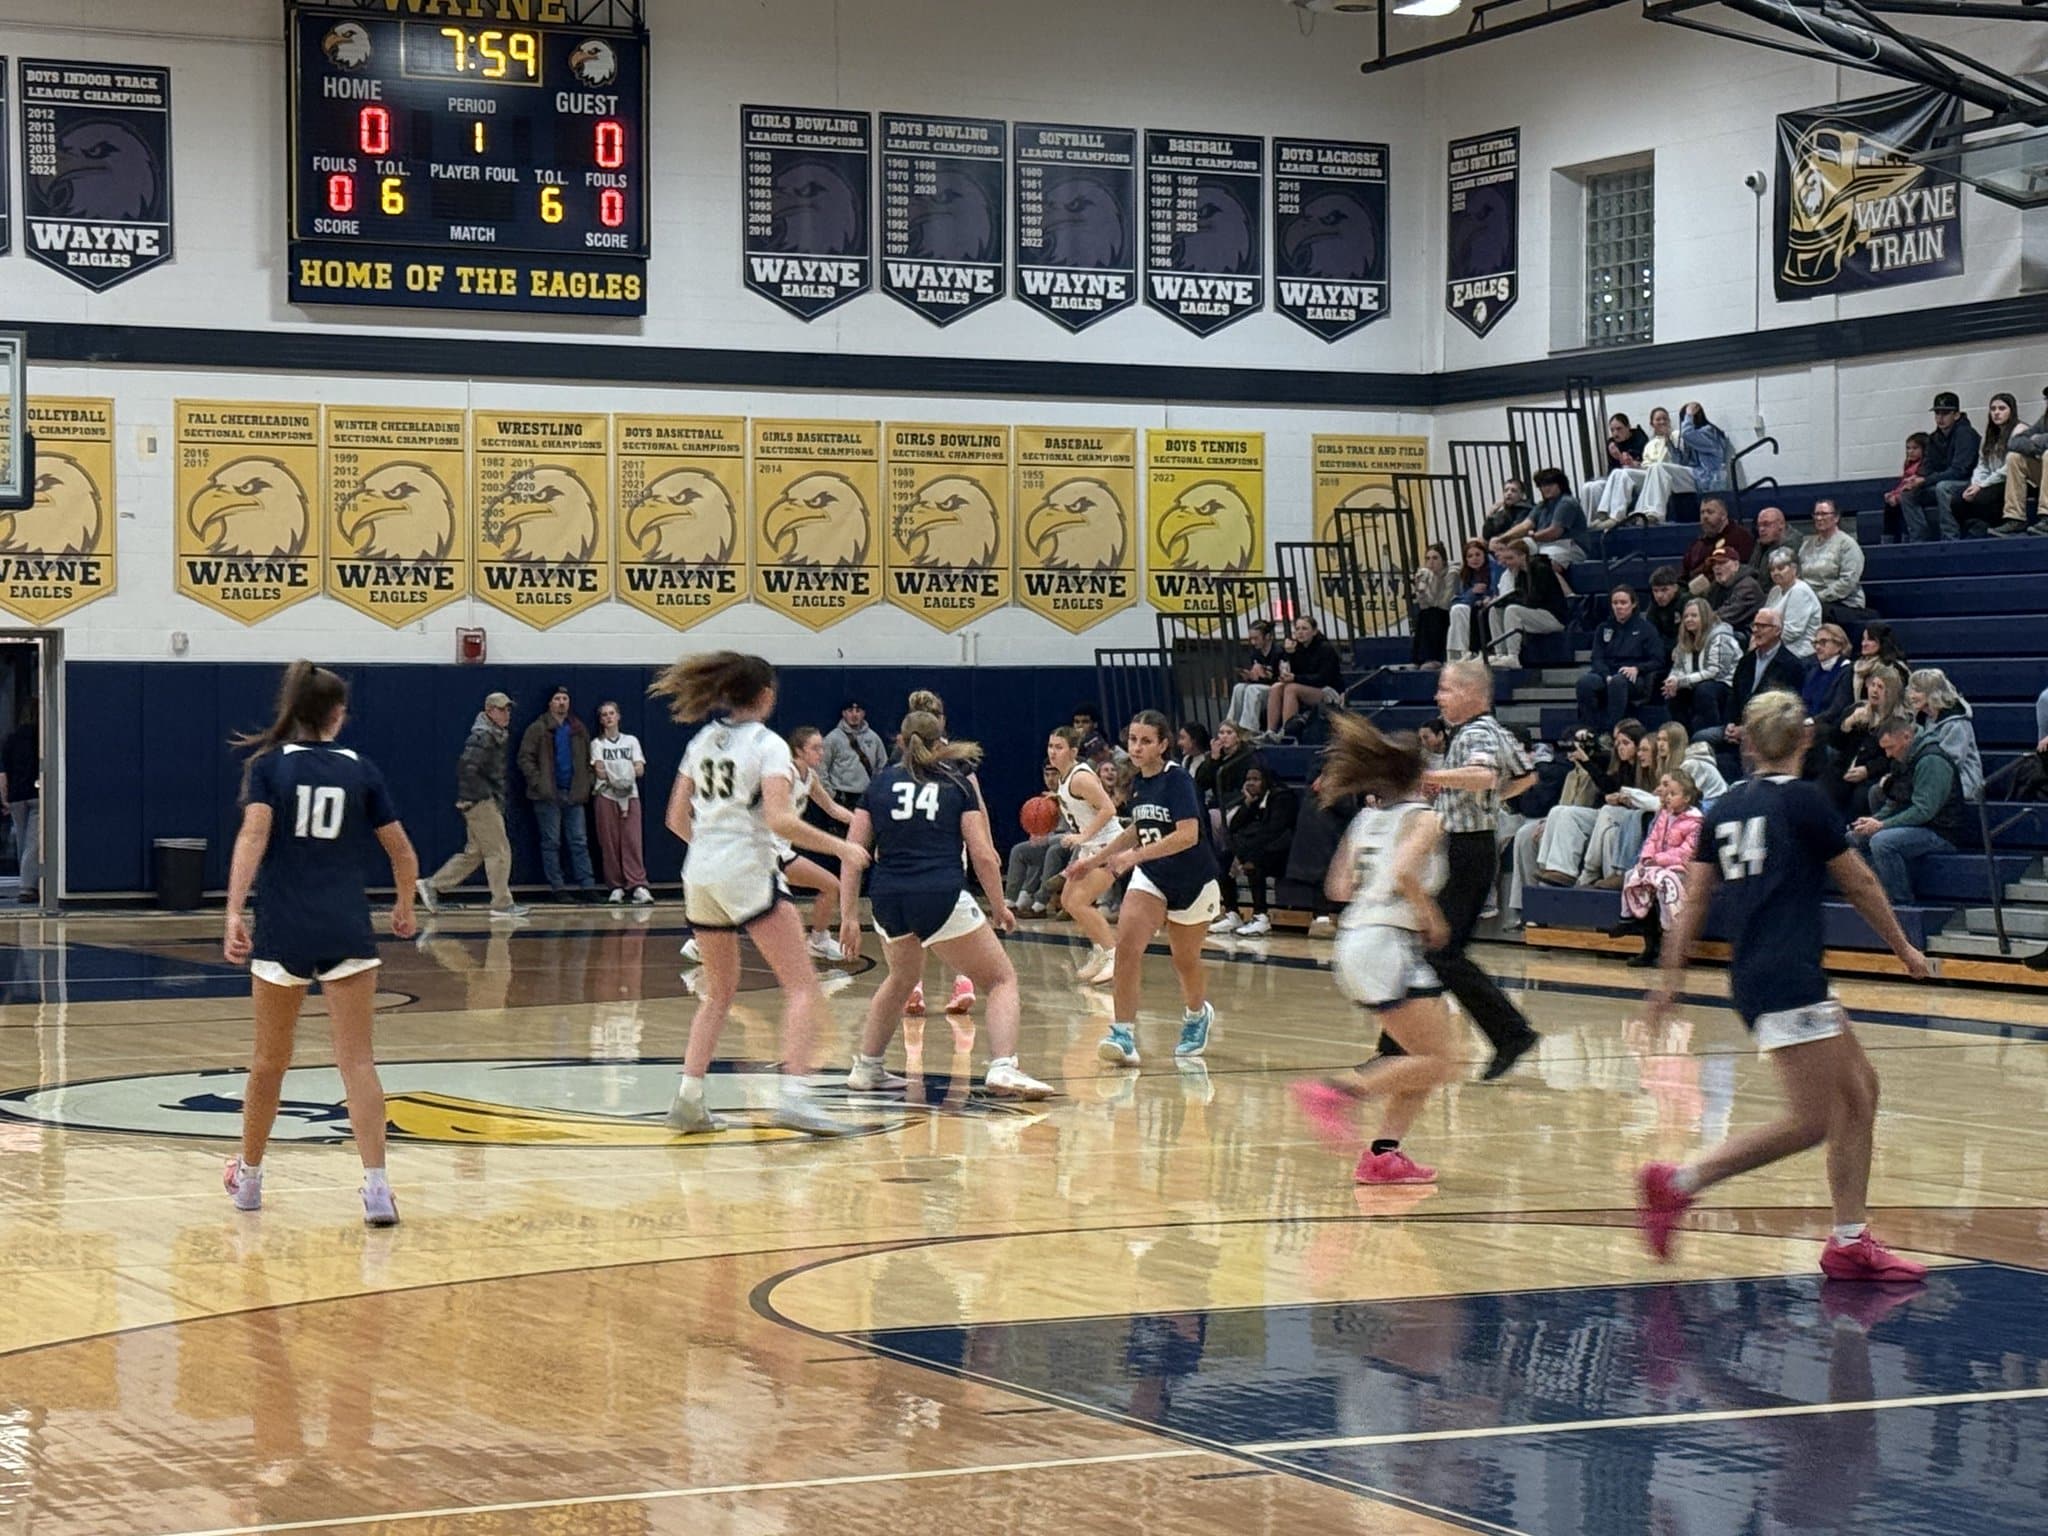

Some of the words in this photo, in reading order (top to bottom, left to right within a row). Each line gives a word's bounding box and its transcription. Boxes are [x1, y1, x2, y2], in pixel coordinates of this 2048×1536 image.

[440, 28, 535, 77] 7:59
[26, 70, 59, 82] BOYS
[64, 72, 112, 87] INDOOR
[115, 75, 158, 89] TRACK
[27, 87, 80, 99] LEAGUE
[83, 90, 162, 104] CHAMPIONS
[323, 76, 383, 101] HOME
[448, 98, 497, 114] PERIOD
[556, 91, 619, 116] GUEST
[27, 108, 55, 119] 2012
[28, 122, 55, 133] 2013
[360, 106, 390, 155] 0
[751, 114, 791, 129] GIRLS
[795, 116, 858, 133] BOWLING
[889, 122, 923, 136] BOYS
[927, 124, 988, 141] BOWLING
[28, 133, 55, 143] 2018
[474, 121, 484, 153] 1
[595, 121, 624, 168] 0
[749, 131, 794, 143] LEAGUE
[796, 134, 865, 147] CHAMPIONS
[1039, 131, 1105, 148] SOFTBALL
[29, 144, 56, 154] 2019
[887, 138, 931, 151] LEAGUE
[933, 142, 1000, 155] CHAMPIONS
[1168, 139, 1233, 155] BASEBALL
[29, 155, 57, 165] 2023
[1021, 148, 1064, 159] LEAGUE
[1066, 150, 1130, 163] CHAMPIONS
[1151, 155, 1193, 166] LEAGUE
[1195, 158, 1258, 170] CHAMPIONS
[1282, 147, 1313, 162] BOYS
[1317, 149, 1379, 166] LACROSSE
[30, 166, 57, 176] 2024
[313, 156, 357, 172] FOULS
[375, 160, 411, 176] T.O.L.
[1279, 162, 1319, 173] LEAGUE
[1322, 165, 1383, 177] CHAMPIONS
[430, 163, 480, 180] PLAYER
[485, 167, 520, 183] FOUL
[534, 169, 569, 185] T.O.L.
[585, 172, 627, 188] FOULS
[329, 175, 353, 212] 0
[381, 178, 404, 215] 6
[541, 187, 563, 224] 6
[601, 189, 624, 227] 0
[1854, 182, 1957, 232] WAYNE
[314, 218, 360, 235] SCORE
[450, 225, 496, 242] MATCH
[31, 222, 160, 256] WAYNE
[585, 232, 629, 248] SCORE
[1866, 225, 1945, 273] TRAIN
[67, 252, 131, 268] EAGLES
[300, 259, 392, 290] HOME
[406, 264, 445, 292] OF
[456, 266, 517, 295] THE
[530, 270, 640, 300] EAGLES
[750, 257, 860, 287] WAYNE
[887, 263, 994, 294] WAYNE
[781, 283, 835, 298] EAGLES
[1022, 270, 1126, 300] WAYNE
[1151, 276, 1252, 304] WAYNE
[1453, 277, 1509, 308] EAGLES
[917, 289, 970, 304] EAGLES
[1051, 296, 1102, 311] EAGLES
[1280, 282, 1378, 310] WAYNE
[1180, 301, 1230, 316] EAGLES
[1306, 307, 1356, 321] EAGLES
[28, 409, 106, 422] OLLEYBALL
[188, 413, 217, 424] FALL
[220, 414, 309, 427] CHEERLEADING
[39, 426, 106, 436] CHAMPIONS
[184, 429, 245, 438] SECTIONAL
[248, 430, 313, 440] CHAMPIONS
[334, 420, 378, 431] WINTER
[381, 421, 460, 433] CHEERLEADING
[497, 421, 582, 436] WRESTLING
[625, 427, 652, 438] BOYS
[656, 428, 724, 439] BASKETBALL
[334, 434, 393, 444] SECTIONAL
[396, 436, 459, 445] CHAMPIONS
[481, 439, 539, 448] SECTIONAL
[541, 440, 602, 449] CHAMPIONS
[762, 432, 793, 442] GIRLS
[797, 432, 862, 444] BASKETBALL
[896, 433, 935, 446] GIRLS
[940, 434, 1001, 447] BOWLING
[1045, 438, 1104, 450] BASEBALL
[183, 448, 209, 458] 2016
[622, 442, 678, 450] SECTIONAL
[681, 443, 740, 452] CHAMPIONS
[760, 446, 814, 455] SECTIONAL
[816, 447, 874, 456] CHAMPIONS
[892, 449, 945, 458] SECTIONAL
[948, 451, 1004, 460] CHAMPIONS
[1165, 440, 1197, 452] BOYS
[1201, 440, 1248, 454] TENNIS
[1317, 445, 1344, 454] GIRLS
[1346, 446, 1376, 455] TRACK
[1378, 447, 1397, 455] AND
[1398, 447, 1424, 456] FIELD
[184, 459, 208, 468] 2017
[1022, 452, 1074, 461] SECTIONAL
[1076, 454, 1130, 463] CHAMPIONS
[1153, 456, 1204, 465] SECTIONAL
[1206, 457, 1259, 466] CHAMPIONS
[1320, 460, 1368, 469] SECTIONAL
[1371, 462, 1422, 470] CHAMPIONS
[333, 466, 358, 476] 2012
[481, 470, 504, 480] 2001
[187, 561, 308, 587] WAYNE
[336, 564, 454, 590] WAYNE
[484, 566, 598, 592] WAYNE
[625, 568, 736, 593] WAYNE
[762, 570, 869, 595] WAYNE
[894, 572, 999, 596] WAYNE
[1024, 574, 1126, 597] WAYNE
[10, 586, 73, 598] EAGLES
[221, 587, 281, 600] EAGLES
[370, 590, 428, 603] EAGLES
[516, 592, 572, 604] EAGLES
[656, 593, 711, 606] EAGLES
[792, 595, 846, 607] EAGLES
[923, 597, 975, 608] EAGLES
[1053, 598, 1104, 610] EAGLES
[1184, 599, 1233, 610] EAGLS
[700, 758, 736, 800] 33
[891, 782, 939, 821] 34
[295, 785, 346, 840] 10
[1714, 815, 1769, 881] 24
